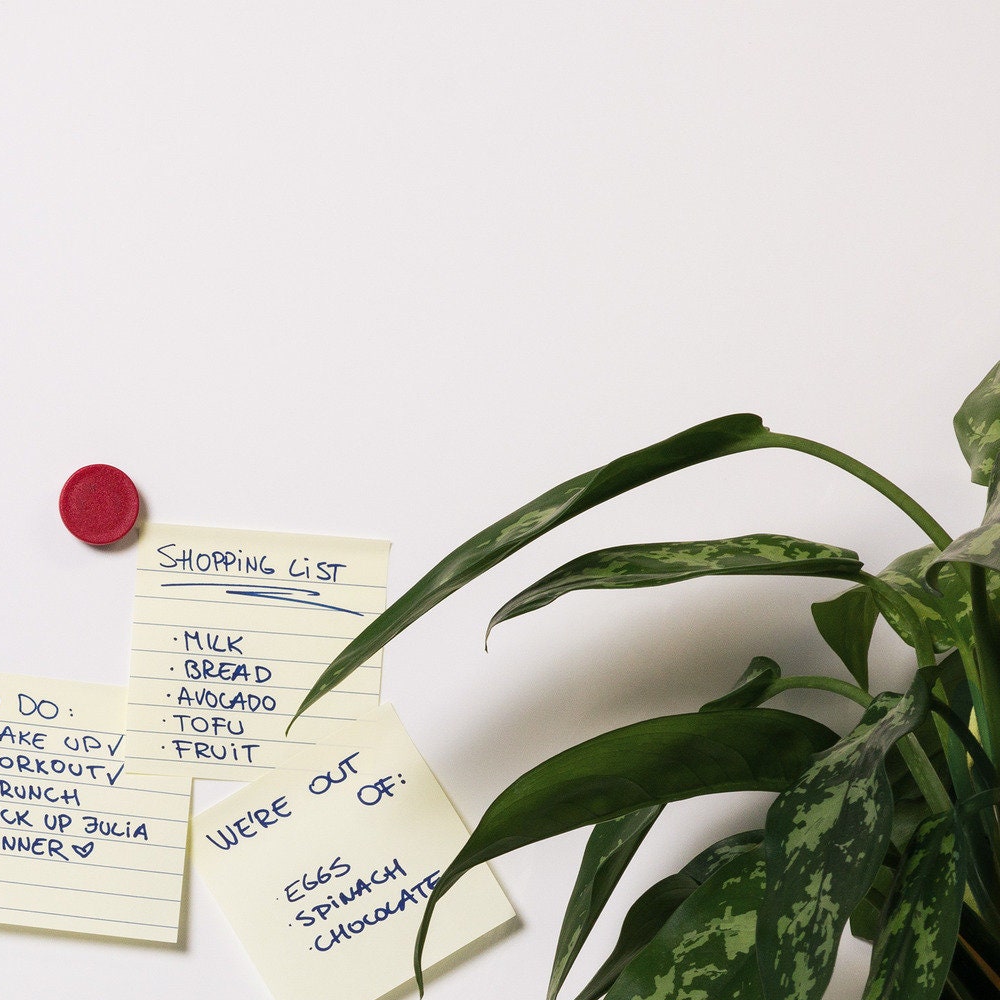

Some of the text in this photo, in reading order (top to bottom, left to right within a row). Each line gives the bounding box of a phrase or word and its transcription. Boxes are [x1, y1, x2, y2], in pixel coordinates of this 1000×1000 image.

[184, 630, 243, 655] MILK
[184, 659, 272, 684] BREAD
[177, 686, 277, 712] AVOCADO
[173, 714, 245, 736] TOFU
[64, 735, 102, 753] UP
[206, 751, 361, 851] WE'RE OUT
[356, 773, 407, 806] OF:
[44, 813, 73, 833] UP
[284, 856, 352, 903] EGGS
[313, 869, 441, 953] CHOCOLATE
